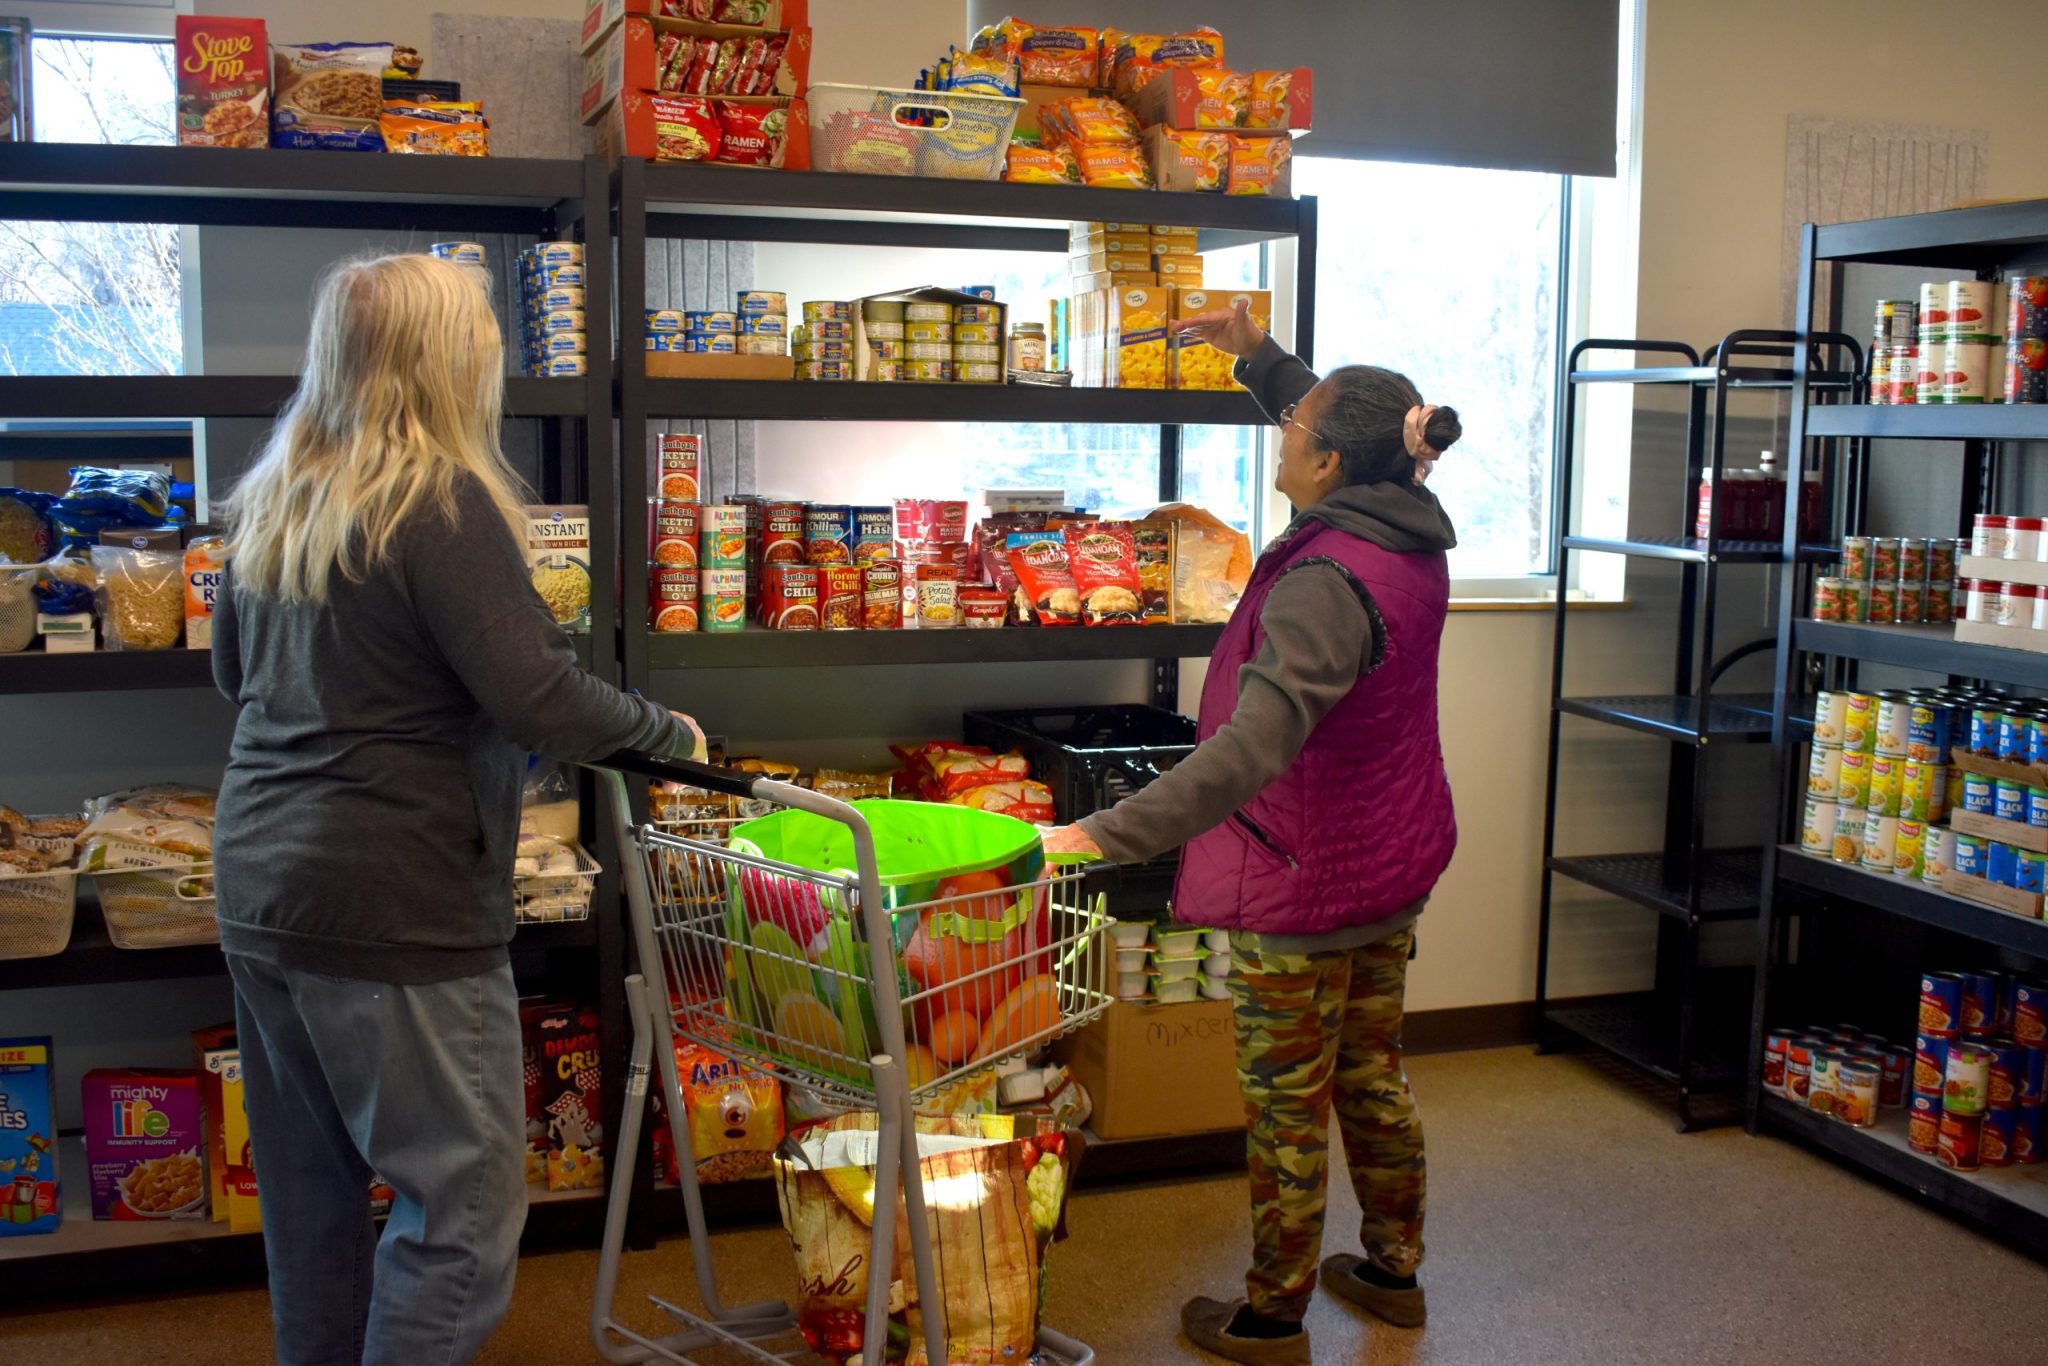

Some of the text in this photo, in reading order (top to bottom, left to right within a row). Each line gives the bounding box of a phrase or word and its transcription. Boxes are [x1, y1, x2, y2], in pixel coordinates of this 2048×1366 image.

[184, 32, 253, 73] Stove
[209, 59, 244, 84] Top
[210, 88, 244, 101] TURKEY
[724, 135, 765, 148] RAMEN
[1010, 154, 1049, 164] RAMEN
[1088, 156, 1127, 166] RAMEN
[1180, 157, 1203, 167] MEN
[1235, 165, 1269, 175] RAMEN
[535, 523, 585, 537] NSTANT
[861, 524, 893, 535] Hash
[564, 540, 581, 548] RICE
[1080, 544, 1121, 555] IDAHOAN
[1025, 551, 1069, 566] IDAHOAN
[712, 575, 745, 584] ALPHABET
[866, 571, 897, 582] CHUNKY
[661, 584, 696, 592] SKETTI
[833, 580, 858, 591] Chili
[928, 587, 952, 595] Potato
[882, 588, 899, 598] MAC
[929, 596, 952, 605] Salad
[1966, 795, 1993, 806] BLACK
[1997, 801, 2024, 812] BLACK
[2031, 809, 2048, 820] BLA
[114, 842, 188, 863] FLICKERTAIL
[557, 1048, 600, 1080] CRU
[110, 1085, 169, 1102] mighty
[112, 1099, 170, 1138] life
[144, 1138, 177, 1146] SUPPORT
